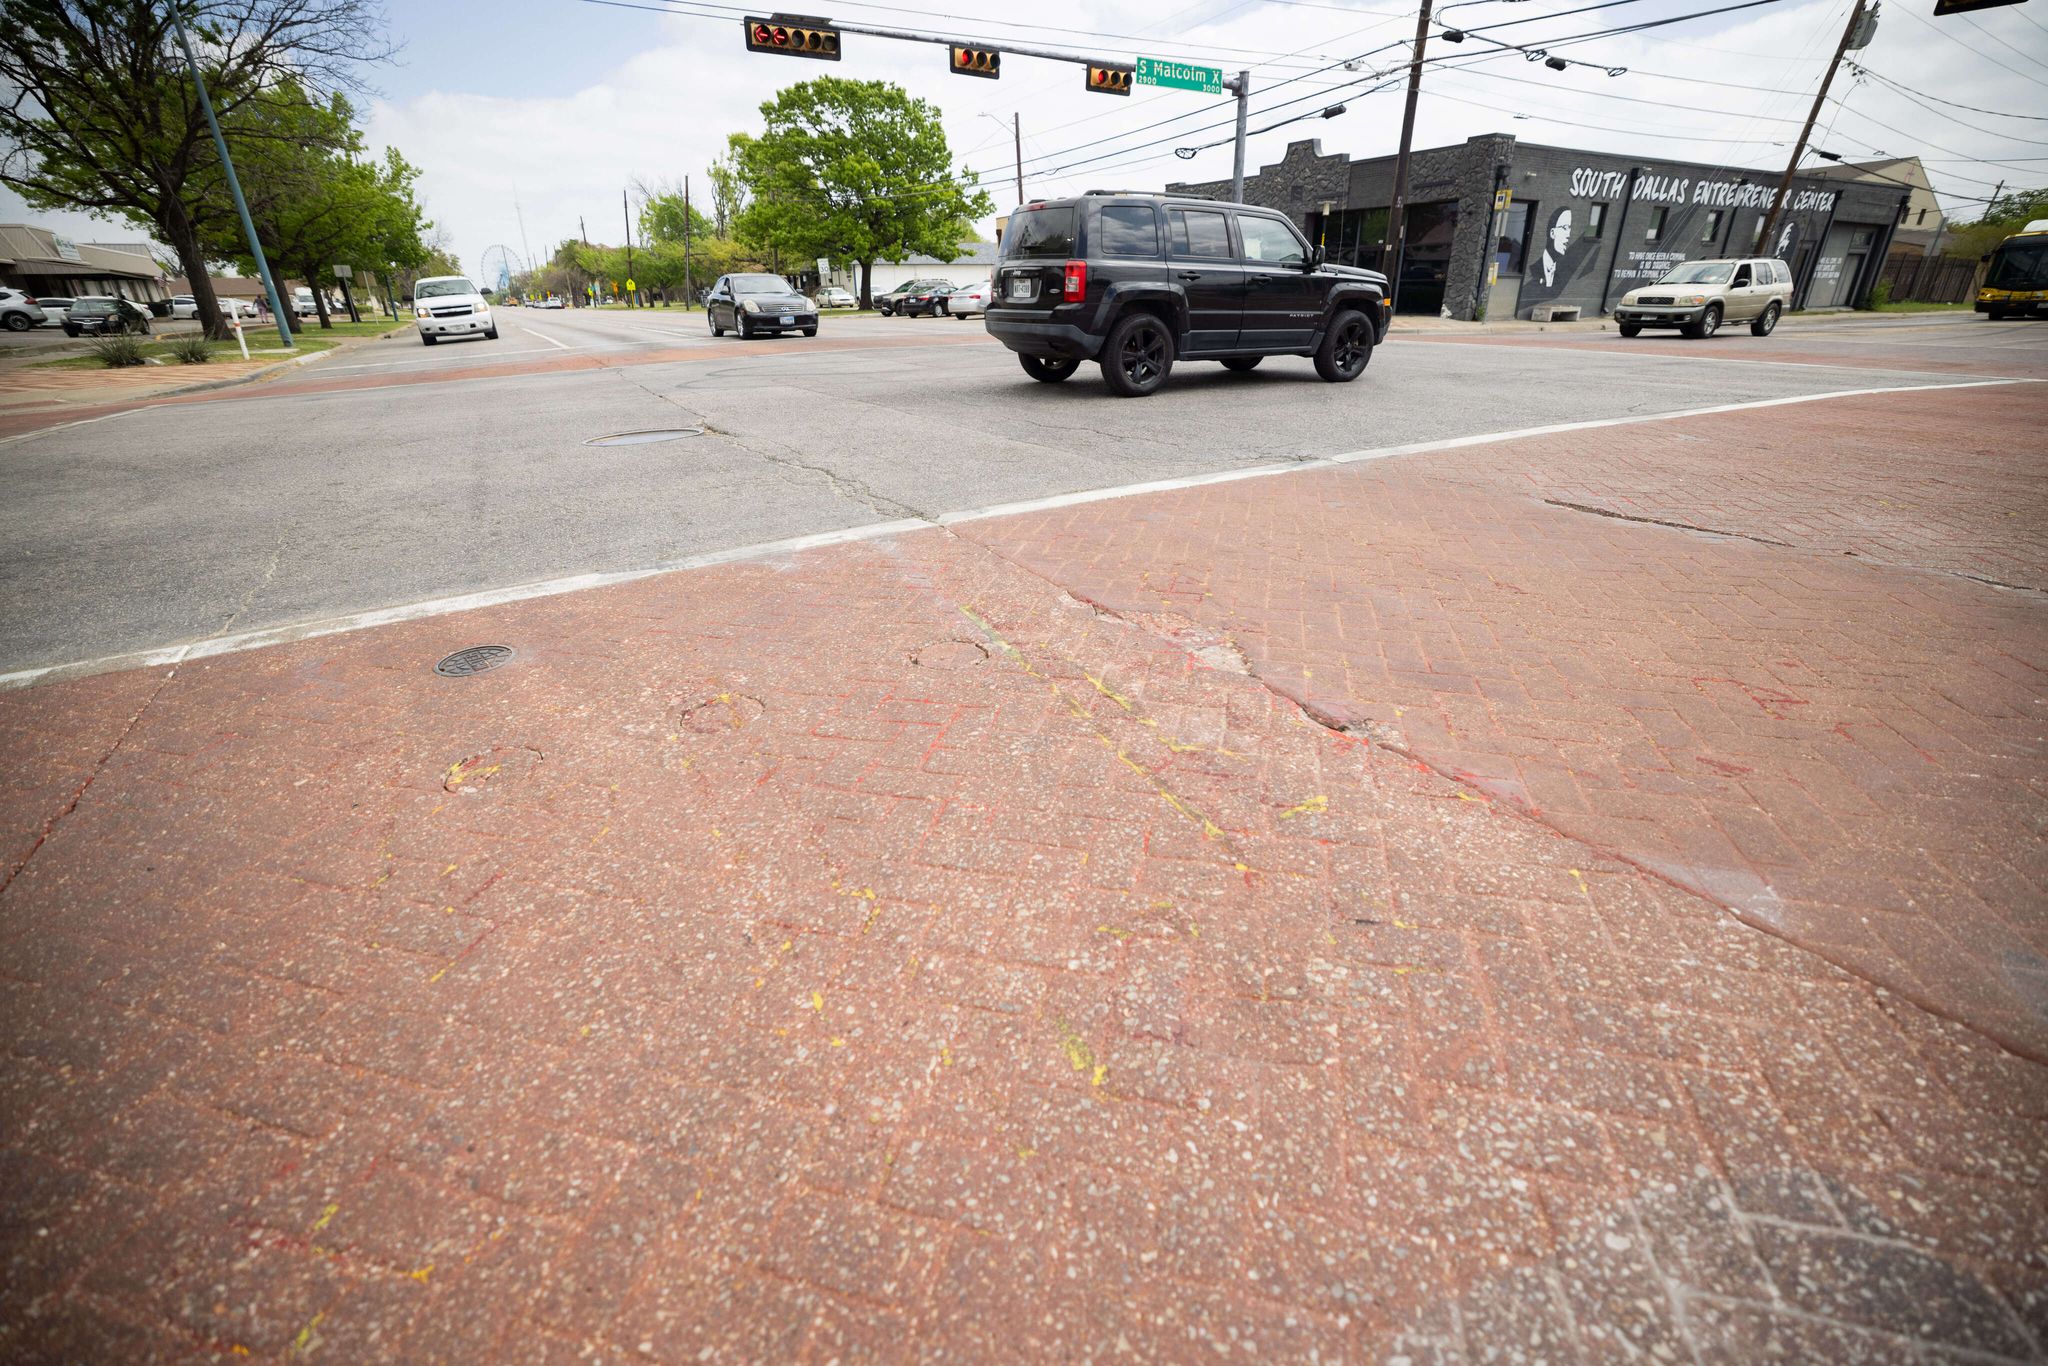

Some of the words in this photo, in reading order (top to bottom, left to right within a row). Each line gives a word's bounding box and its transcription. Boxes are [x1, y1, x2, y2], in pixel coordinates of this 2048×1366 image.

[1140, 60, 1147, 74] S
[1154, 62, 1206, 82] Malcolm
[1212, 71, 1220, 84] X
[1203, 84, 1220, 93] 3000
[1569, 167, 1627, 199] SOUTH
[1632, 175, 1689, 204] DALLAS
[1692, 180, 1792, 210] ENTREPRENER
[1794, 190, 1836, 211] CENTER
